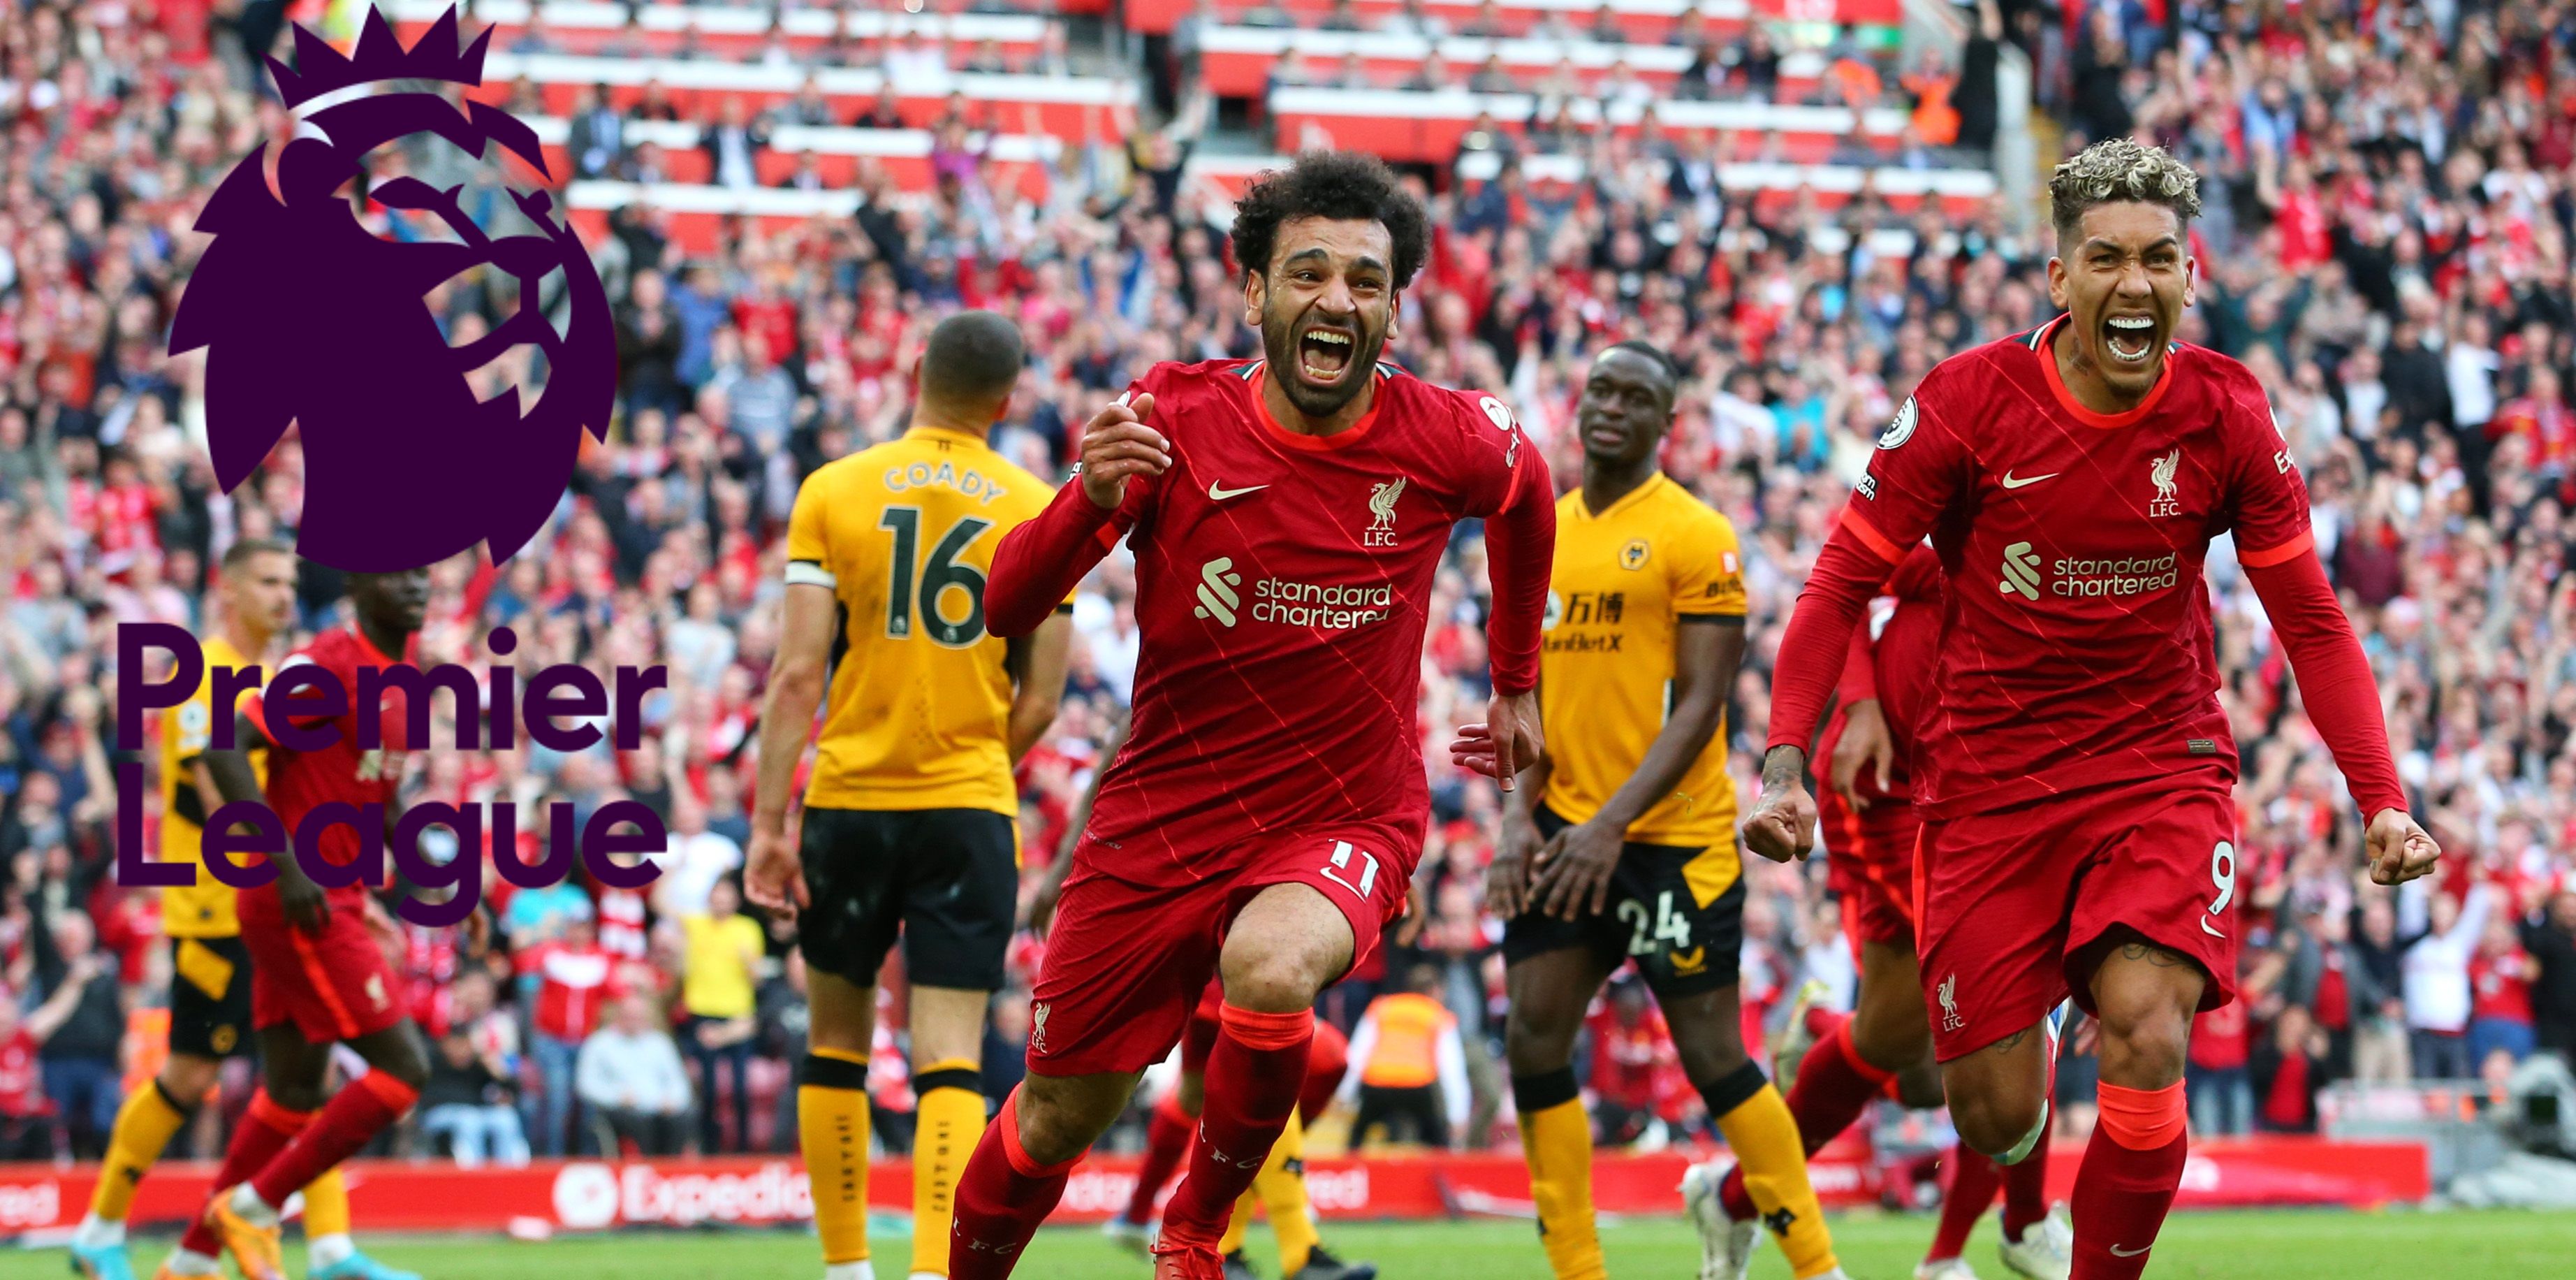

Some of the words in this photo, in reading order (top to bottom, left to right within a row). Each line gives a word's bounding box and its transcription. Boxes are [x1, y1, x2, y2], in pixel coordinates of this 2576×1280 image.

[885, 462, 1007, 506] COADY
[1363, 532, 1398, 546] L.F.C.
[878, 504, 996, 650] 16
[2051, 567, 2178, 597] chartered
[2053, 551, 2176, 576] standard
[1254, 576, 1392, 606] standard
[1328, 838, 1380, 898] 11
[2208, 841, 2235, 916] 9
[1616, 889, 1691, 956] 24
